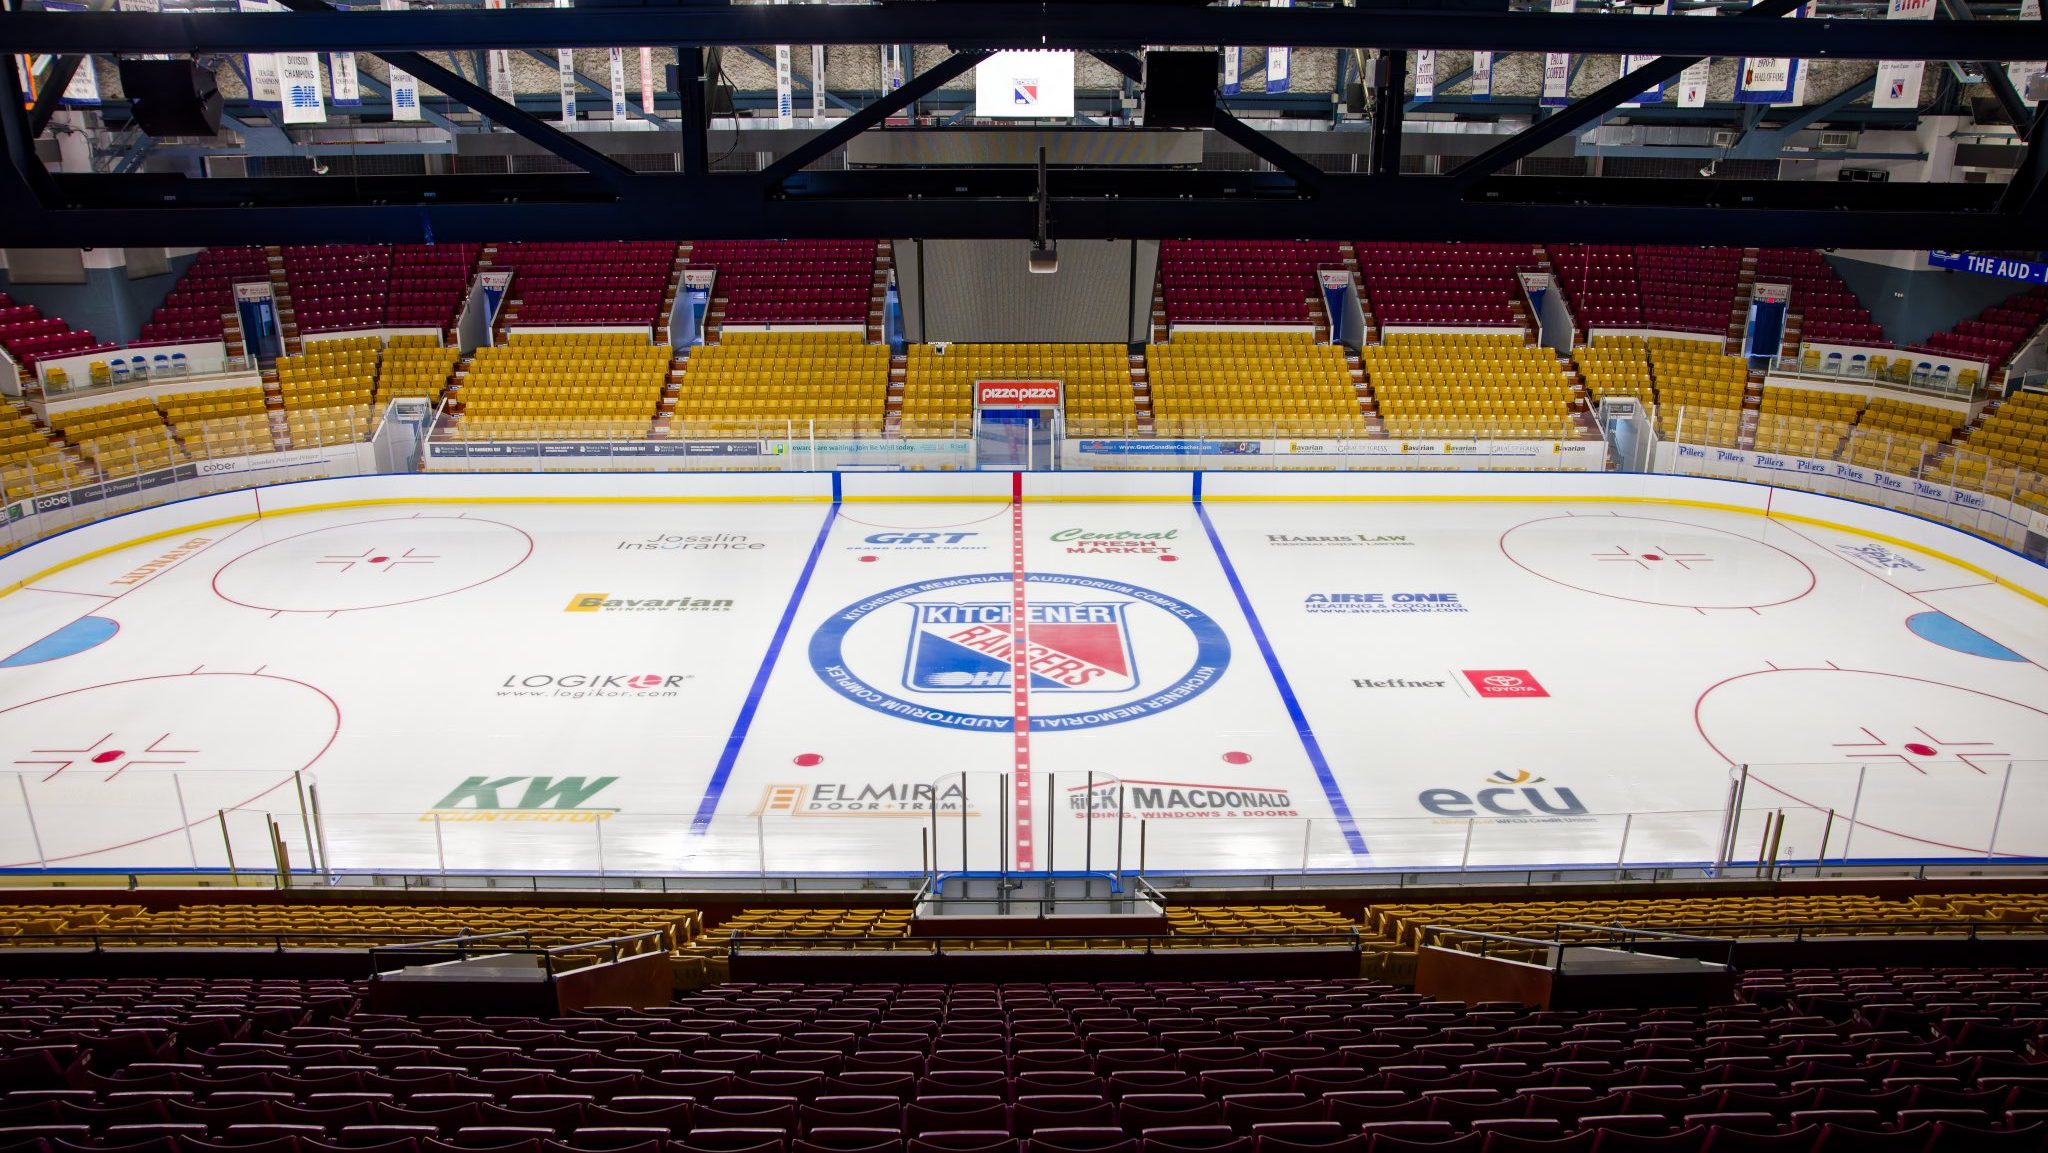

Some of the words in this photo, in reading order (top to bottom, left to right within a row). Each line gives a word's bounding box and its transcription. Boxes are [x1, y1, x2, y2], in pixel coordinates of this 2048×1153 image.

[288, 56, 308, 65] DIVISION
[285, 69, 315, 79] CHAMPIONS
[1968, 255, 1995, 274] THE
[1997, 262, 2030, 279] AUD
[982, 388, 1018, 401] pizza
[1019, 388, 1056, 401] pizza
[1679, 446, 1704, 457] Pillers
[1717, 450, 1744, 462] Pillers
[203, 461, 236, 472] cober
[1756, 455, 1784, 467] Pillers
[1796, 460, 1825, 472] Pilers
[1837, 466, 1863, 479] Pilers
[1874, 473, 1901, 488] Pllers
[648, 533, 747, 542] Josslin
[864, 533, 979, 543] GRT
[1050, 528, 1178, 542] Central
[617, 541, 766, 550] Insurance
[579, 597, 734, 607] Bavarian
[841, 588, 917, 622] KITCHENER
[919, 575, 1011, 592] MEMORIAL
[1028, 575, 1130, 595] AUDITORIUM
[1133, 590, 1200, 619] COMPLEX
[1304, 593, 1385, 603] AIRE
[1391, 593, 1459, 603] ONE
[503, 675, 684, 689] LOGIKOR
[825, 665, 882, 702] COMPLEX
[1148, 666, 1216, 709] KITCHENER
[1352, 679, 1446, 688] Heffner
[496, 689, 678, 699] www.logikor.com
[879, 700, 1010, 728] AUDITORIUM
[1032, 704, 1147, 728] MEMORIAL
[432, 776, 621, 809] KW
[812, 784, 969, 801] ELMIRA
[1132, 787, 1290, 809] MACDONALD
[1418, 787, 1590, 816] ecu
[1075, 811, 1136, 819] SDING,
[1142, 810, 1221, 818] WINDOWS
